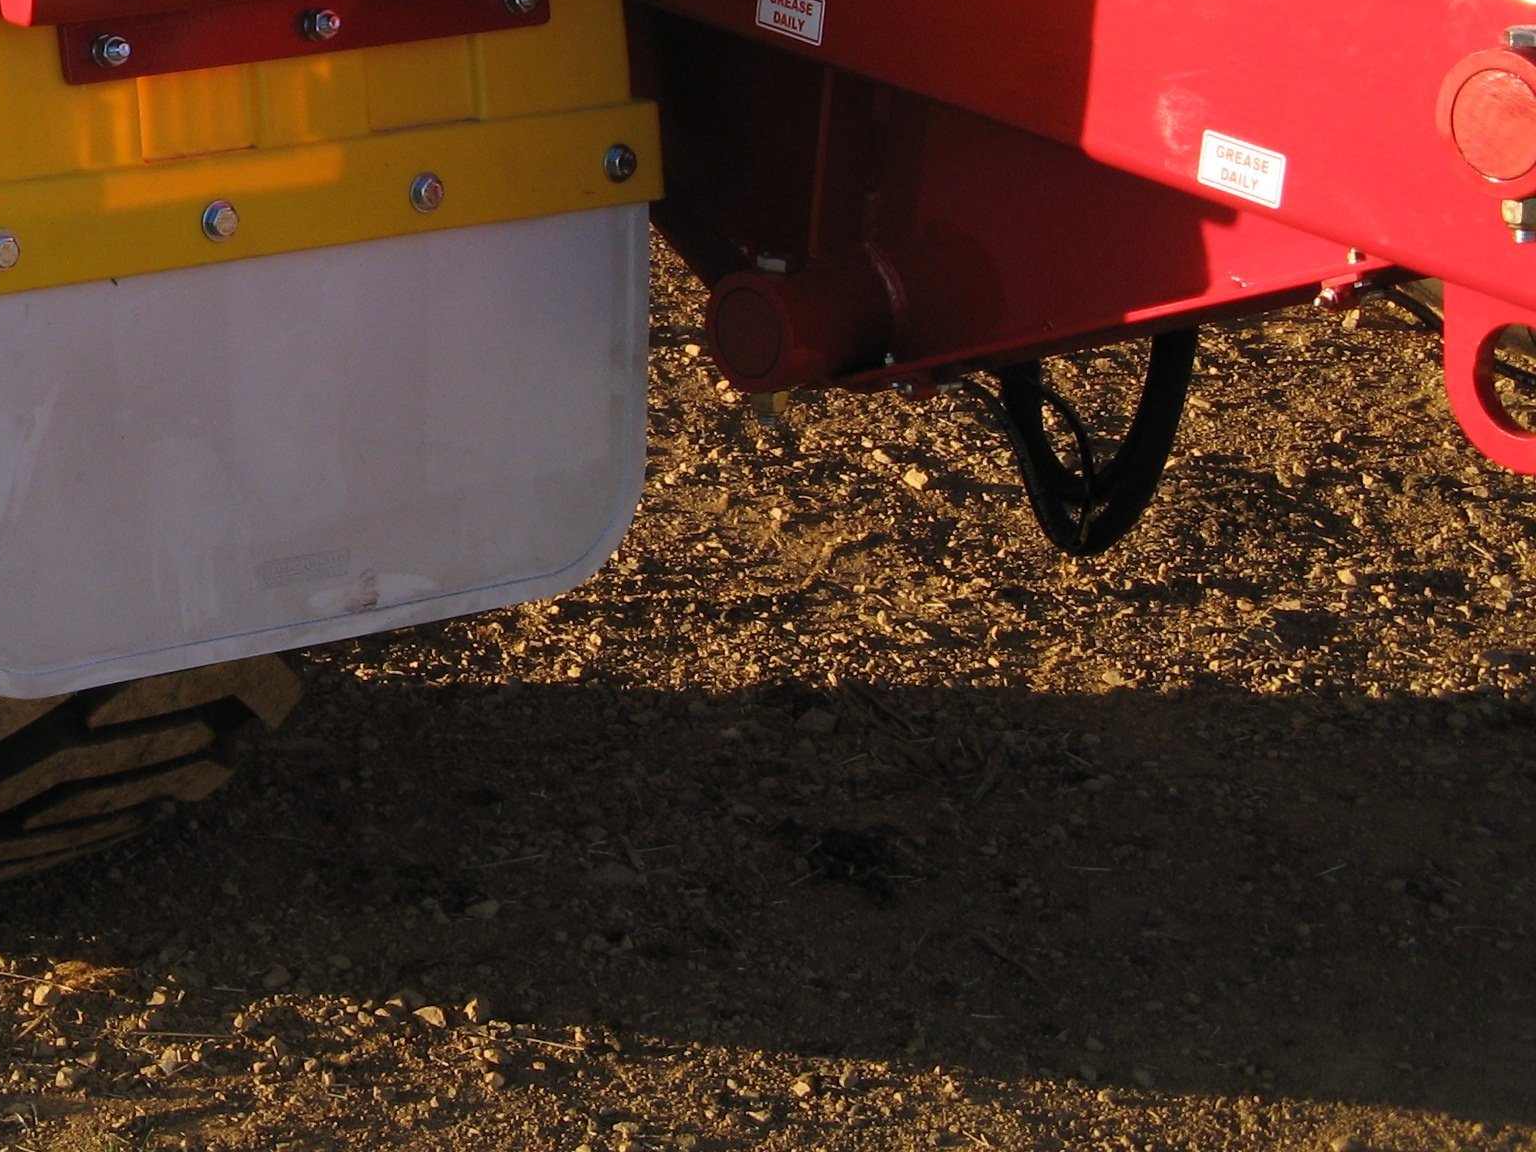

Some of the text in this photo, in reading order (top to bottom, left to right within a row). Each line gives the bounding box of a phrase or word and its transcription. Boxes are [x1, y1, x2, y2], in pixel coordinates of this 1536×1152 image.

[773, 10, 806, 32] DAILY
[1216, 144, 1270, 174] GREASE
[1220, 167, 1259, 190] DAILY
